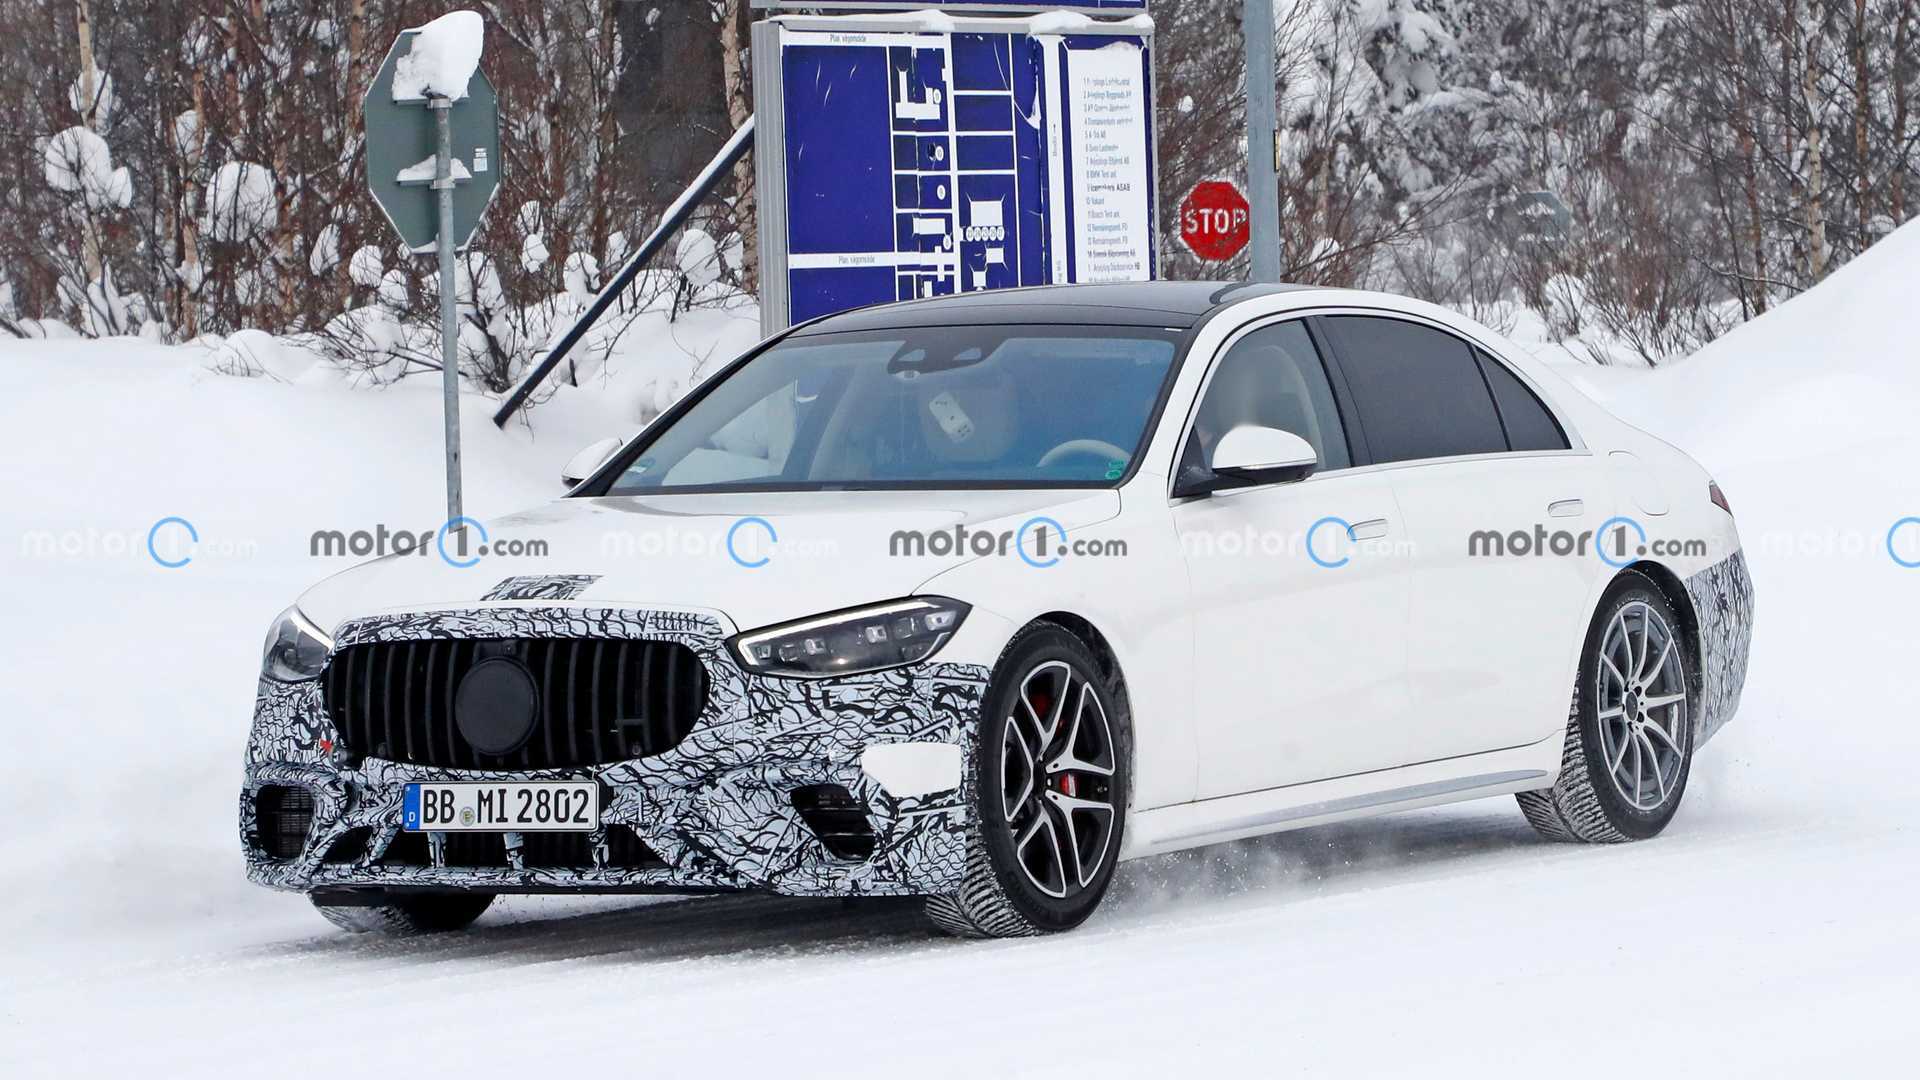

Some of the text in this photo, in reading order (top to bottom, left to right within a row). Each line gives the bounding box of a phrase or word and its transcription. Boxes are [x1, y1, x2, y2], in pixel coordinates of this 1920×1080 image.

[1185, 208, 1247, 234] STOP
[423, 788, 589, 823] BB MI 2802
